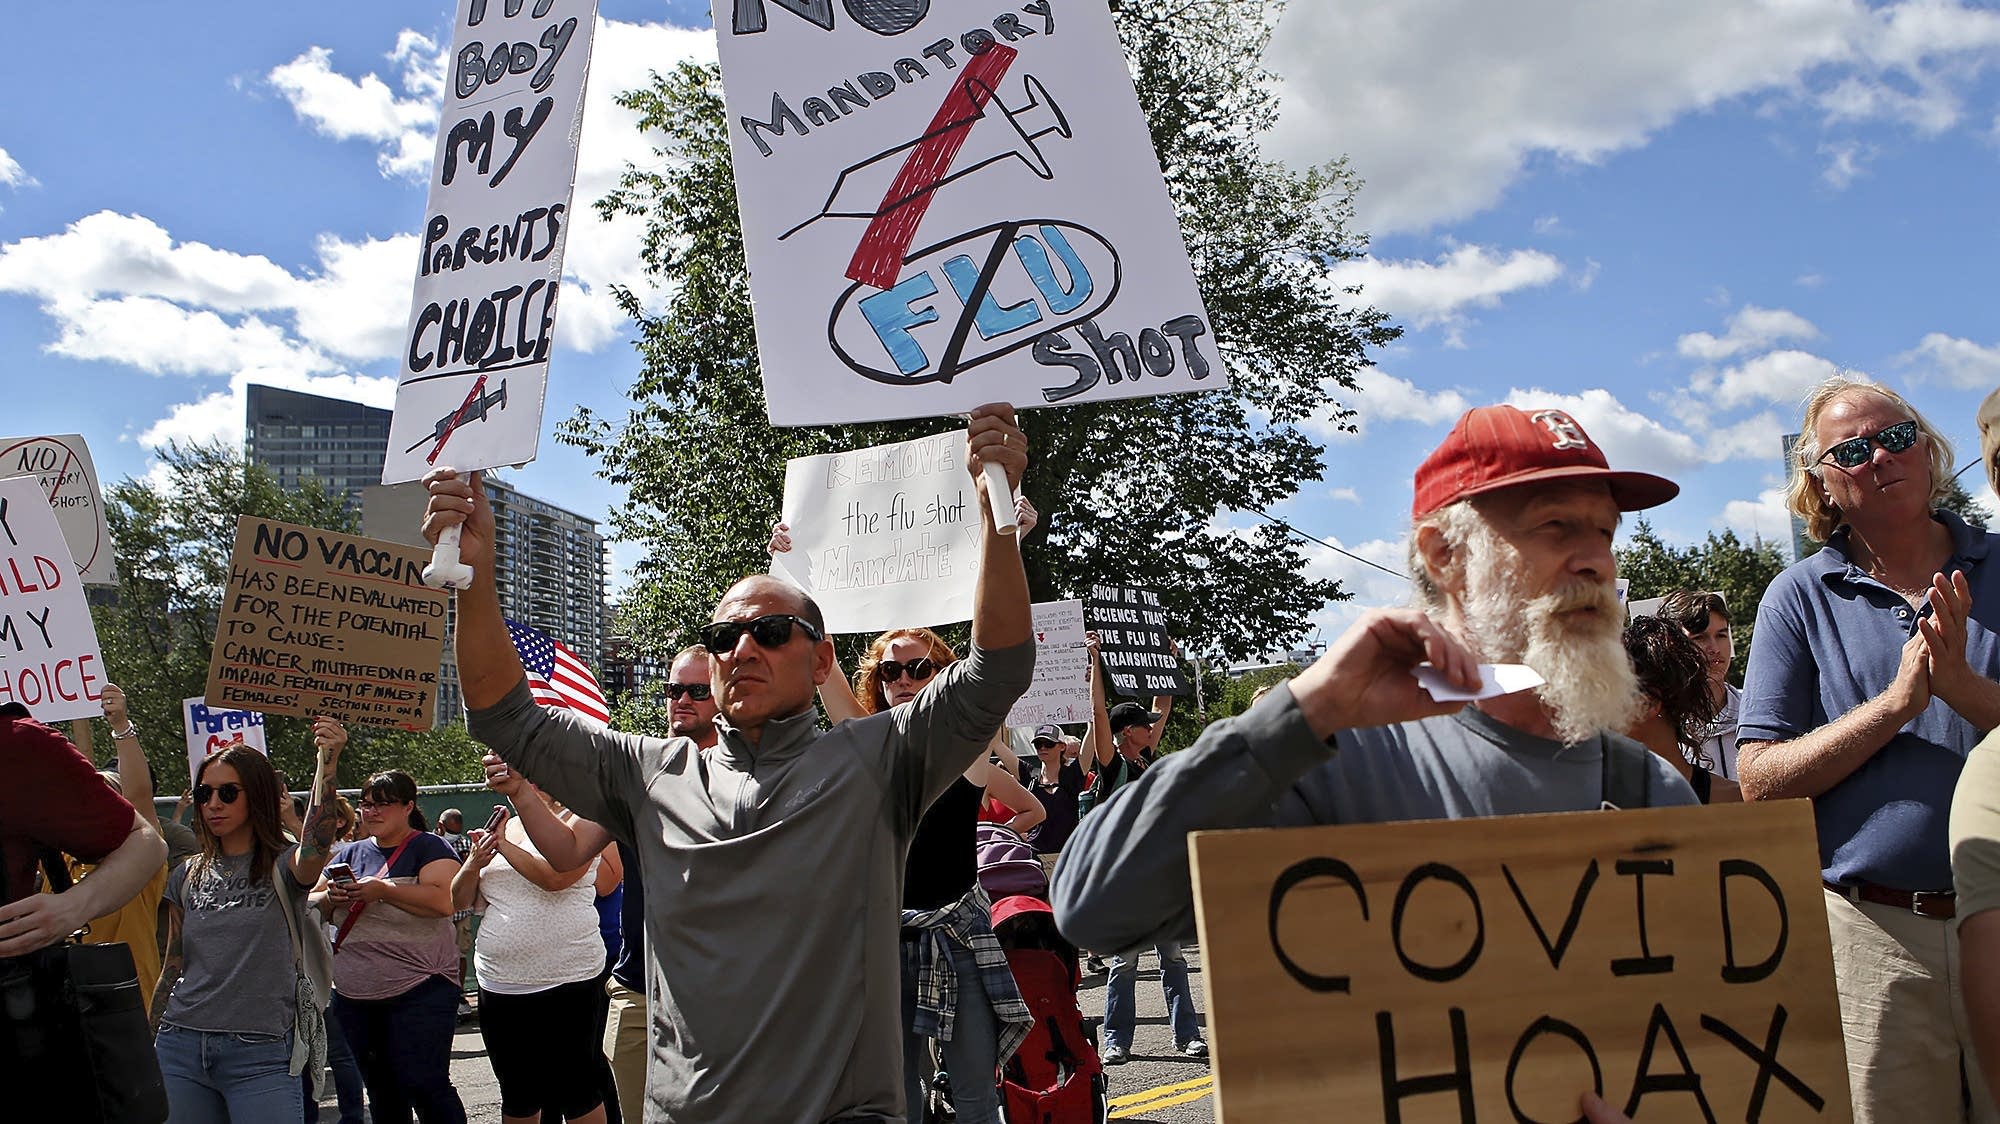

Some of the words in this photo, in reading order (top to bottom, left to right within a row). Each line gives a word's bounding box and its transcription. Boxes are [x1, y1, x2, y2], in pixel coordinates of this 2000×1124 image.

[455, 17, 578, 99] BODY
[741, 0, 1055, 158] MANDATORY
[441, 97, 554, 188] MY
[421, 203, 566, 277] PARENTS
[857, 224, 1094, 376] FLU
[408, 278, 558, 374] CHOICE
[17, 447, 57, 472] NO
[826, 433, 956, 489] REMOVE
[51, 495, 90, 508] SHOTS
[841, 501, 880, 537] the
[886, 491, 916, 532] flu
[923, 490, 967, 526] shot
[254, 523, 309, 561] NO
[317, 536, 429, 587] VACCIN
[230, 564, 279, 592] HAS
[283, 575, 347, 602] BEEN
[350, 586, 444, 618] EVALUATED
[1091, 583, 1119, 603] SHOW
[1124, 588, 1138, 604] ME
[1141, 590, 1160, 607] THE
[226, 620, 257, 636] TO
[267, 625, 346, 652] CAUSE:
[232, 593, 285, 625] FOR
[291, 603, 334, 628] THE
[337, 611, 440, 641] POTENTIAL
[1092, 606, 1139, 624] SCIENCE
[1142, 610, 1165, 626] THAT
[1097, 629, 1121, 644] THE
[1126, 630, 1146, 646] FLU
[1149, 631, 1161, 647] IS
[218, 665, 281, 687] IMPAIR
[282, 674, 353, 699] FERTILITY
[355, 683, 372, 697] OF
[420, 672, 437, 683] OR
[1100, 651, 1178, 669] TRANSMITTED
[1111, 672, 1139, 689] OVER
[1145, 674, 1178, 690] ZOOM
[222, 686, 299, 707] FEMALES!
[318, 696, 372, 713] SECTION
[396, 707, 412, 715] ON
[355, 715, 400, 726] INSERT
[1267, 856, 1790, 997] COVID
[1374, 1002, 1826, 1124] HOAX
